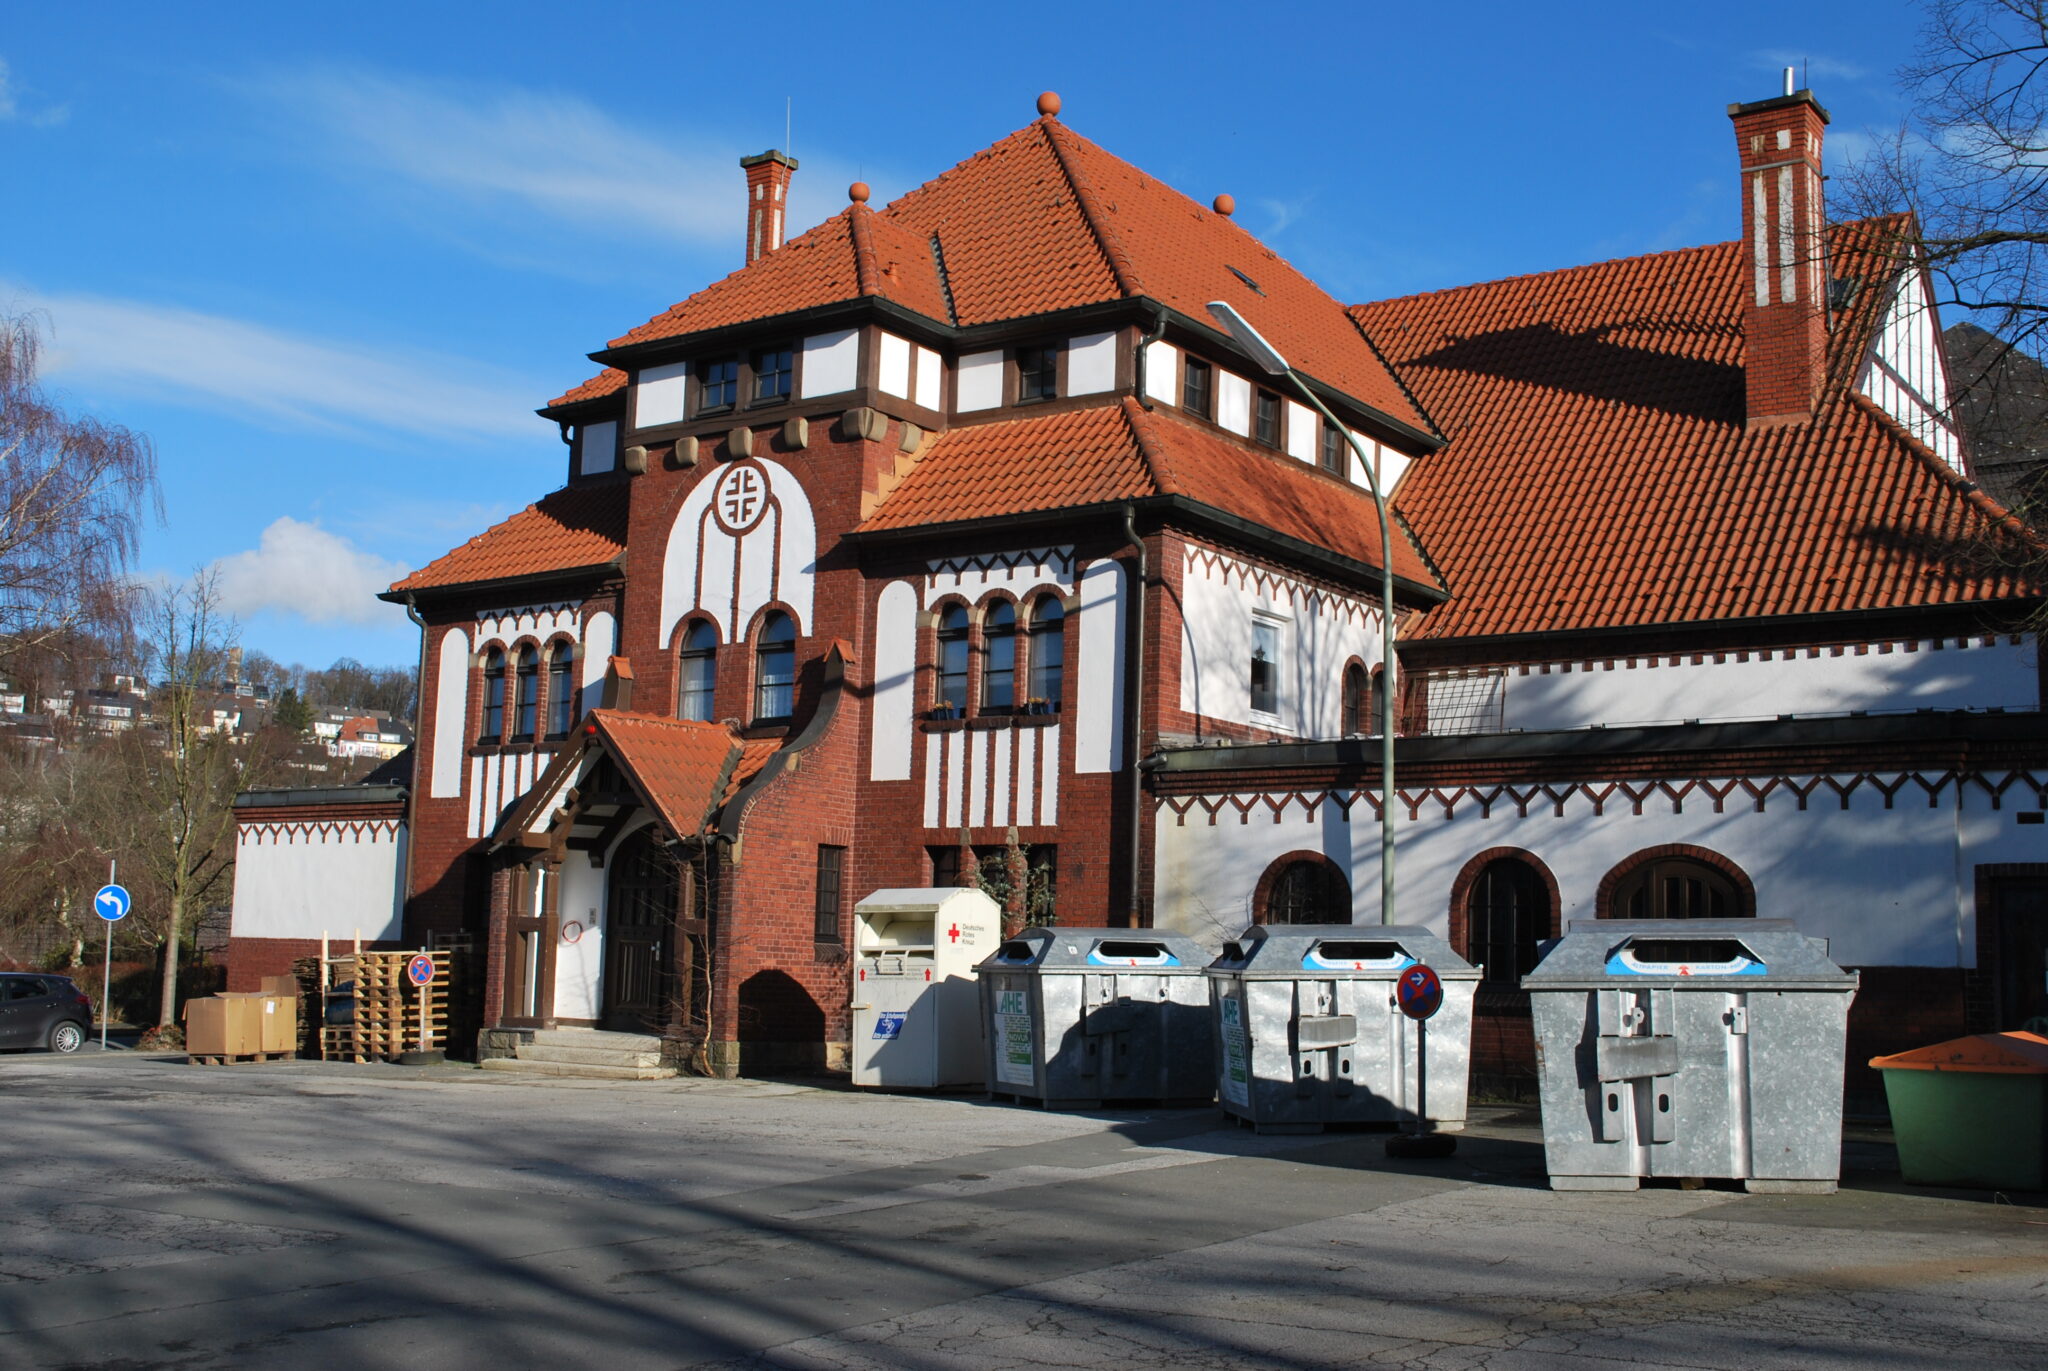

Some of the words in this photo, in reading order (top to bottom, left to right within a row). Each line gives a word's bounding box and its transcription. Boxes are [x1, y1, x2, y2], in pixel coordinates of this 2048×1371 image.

[962, 923, 985, 932] Deutsches
[1000, 992, 1023, 1014] AHE
[1224, 1000, 1238, 1025] AHE
